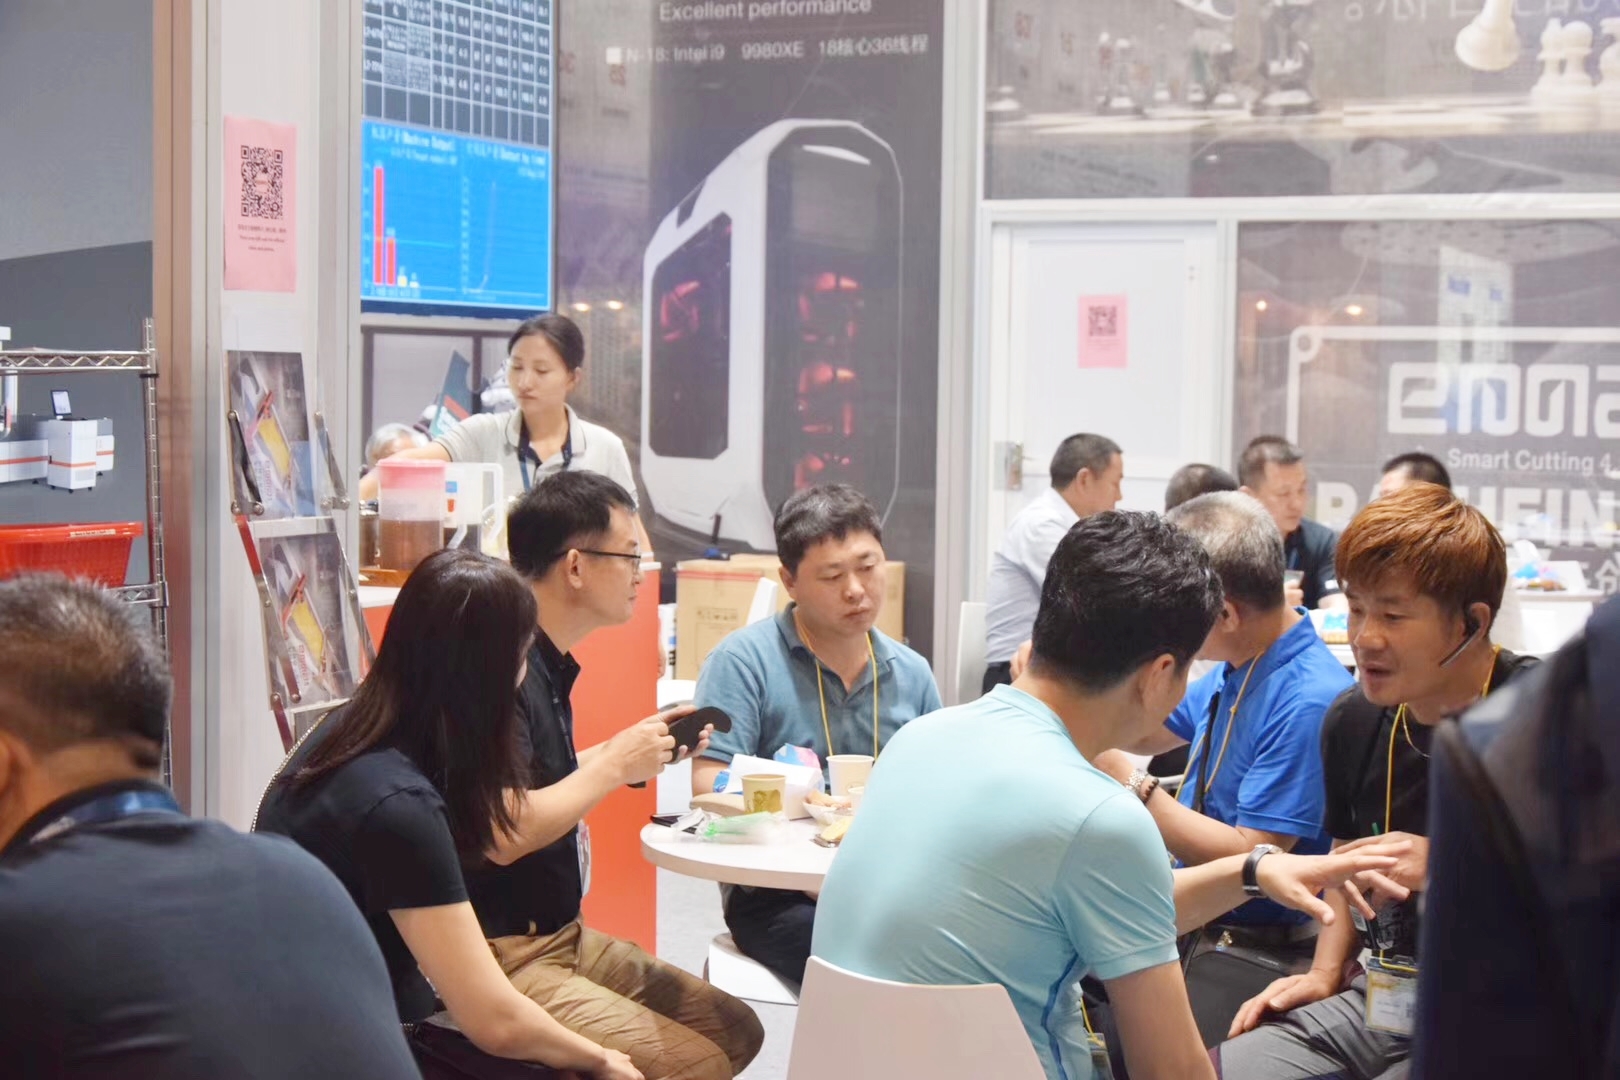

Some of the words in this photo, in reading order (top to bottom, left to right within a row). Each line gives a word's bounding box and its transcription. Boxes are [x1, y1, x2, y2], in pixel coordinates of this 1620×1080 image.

[658, 1, 744, 22] Excellent
[748, 0, 871, 20] performance
[741, 40, 805, 60] 9980XE
[1448, 448, 1510, 471] Smart
[1515, 450, 1594, 477] Cutting
